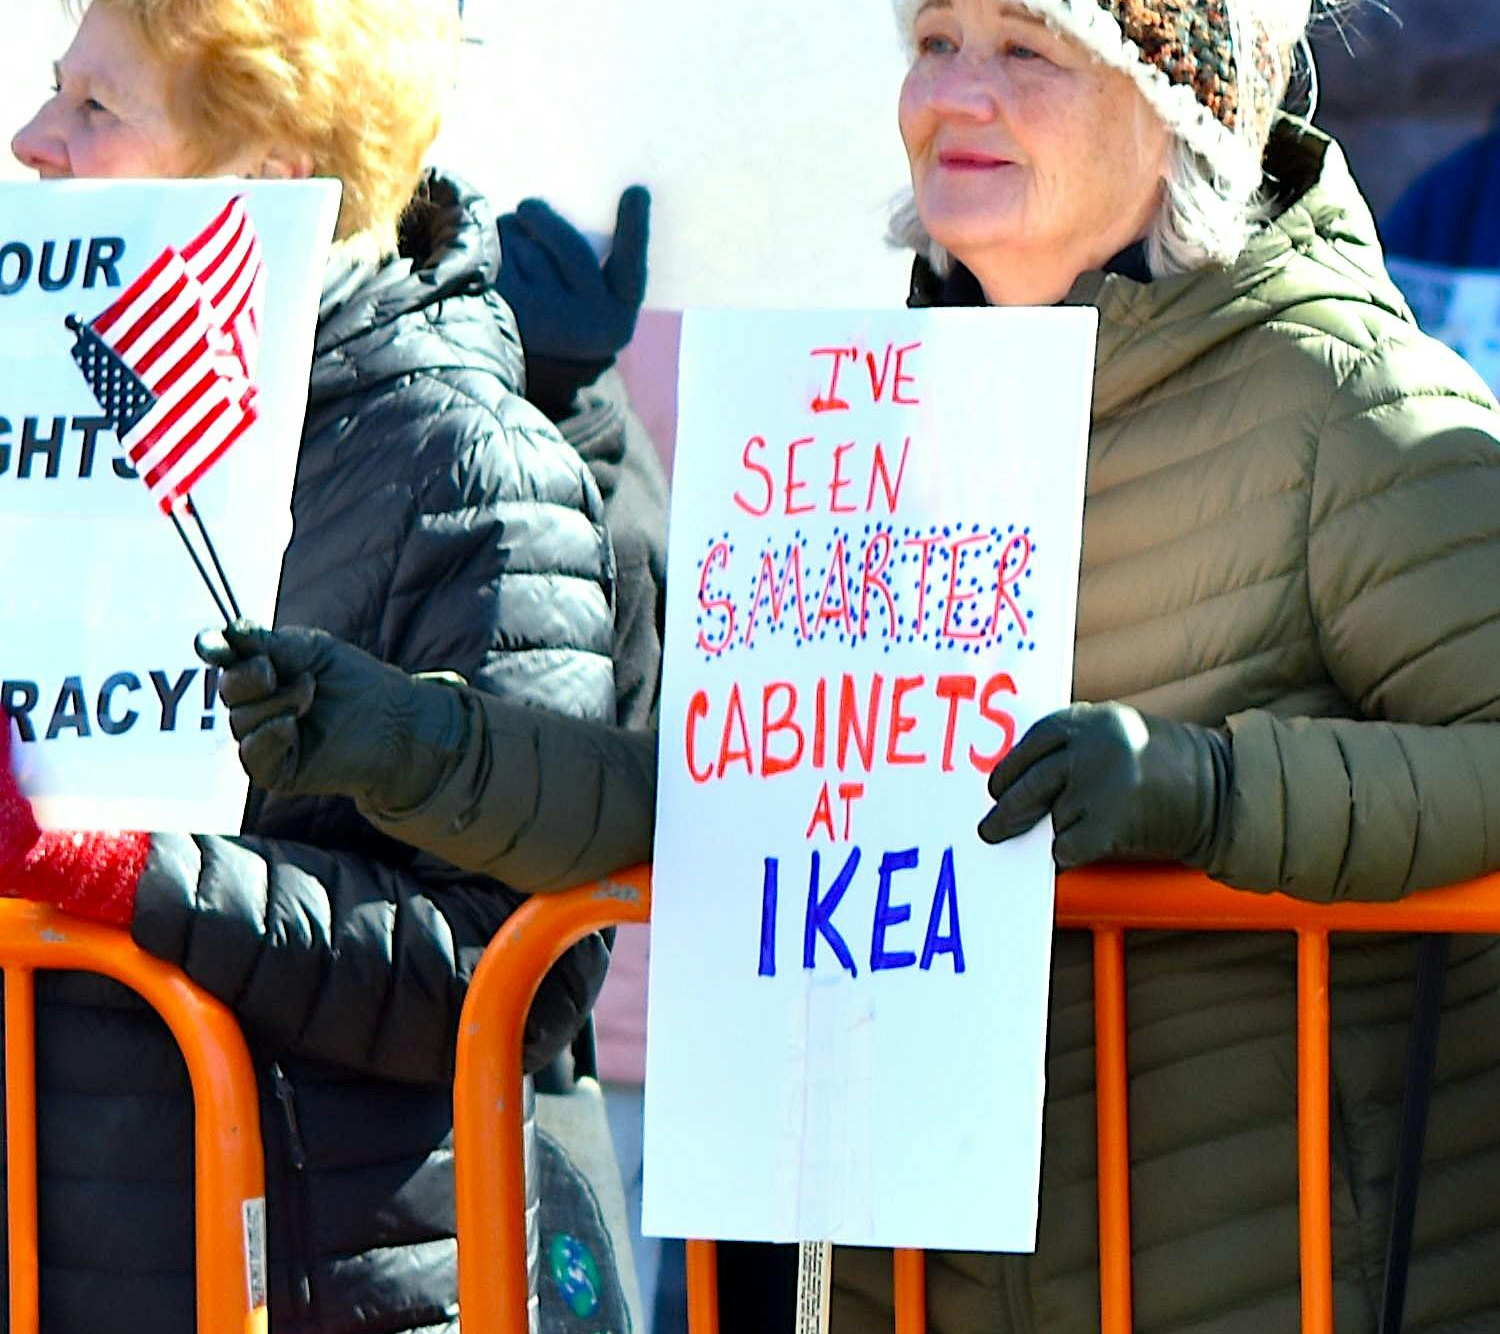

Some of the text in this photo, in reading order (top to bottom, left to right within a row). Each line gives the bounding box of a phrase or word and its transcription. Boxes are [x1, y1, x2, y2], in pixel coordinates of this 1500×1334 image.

[810, 341, 923, 413] I'VE
[733, 435, 912, 516] SEEN
[697, 527, 1034, 656] SMARTER
[685, 671, 1018, 785] CABINETS
[806, 782, 865, 842] AT
[757, 845, 966, 979] IKEA
